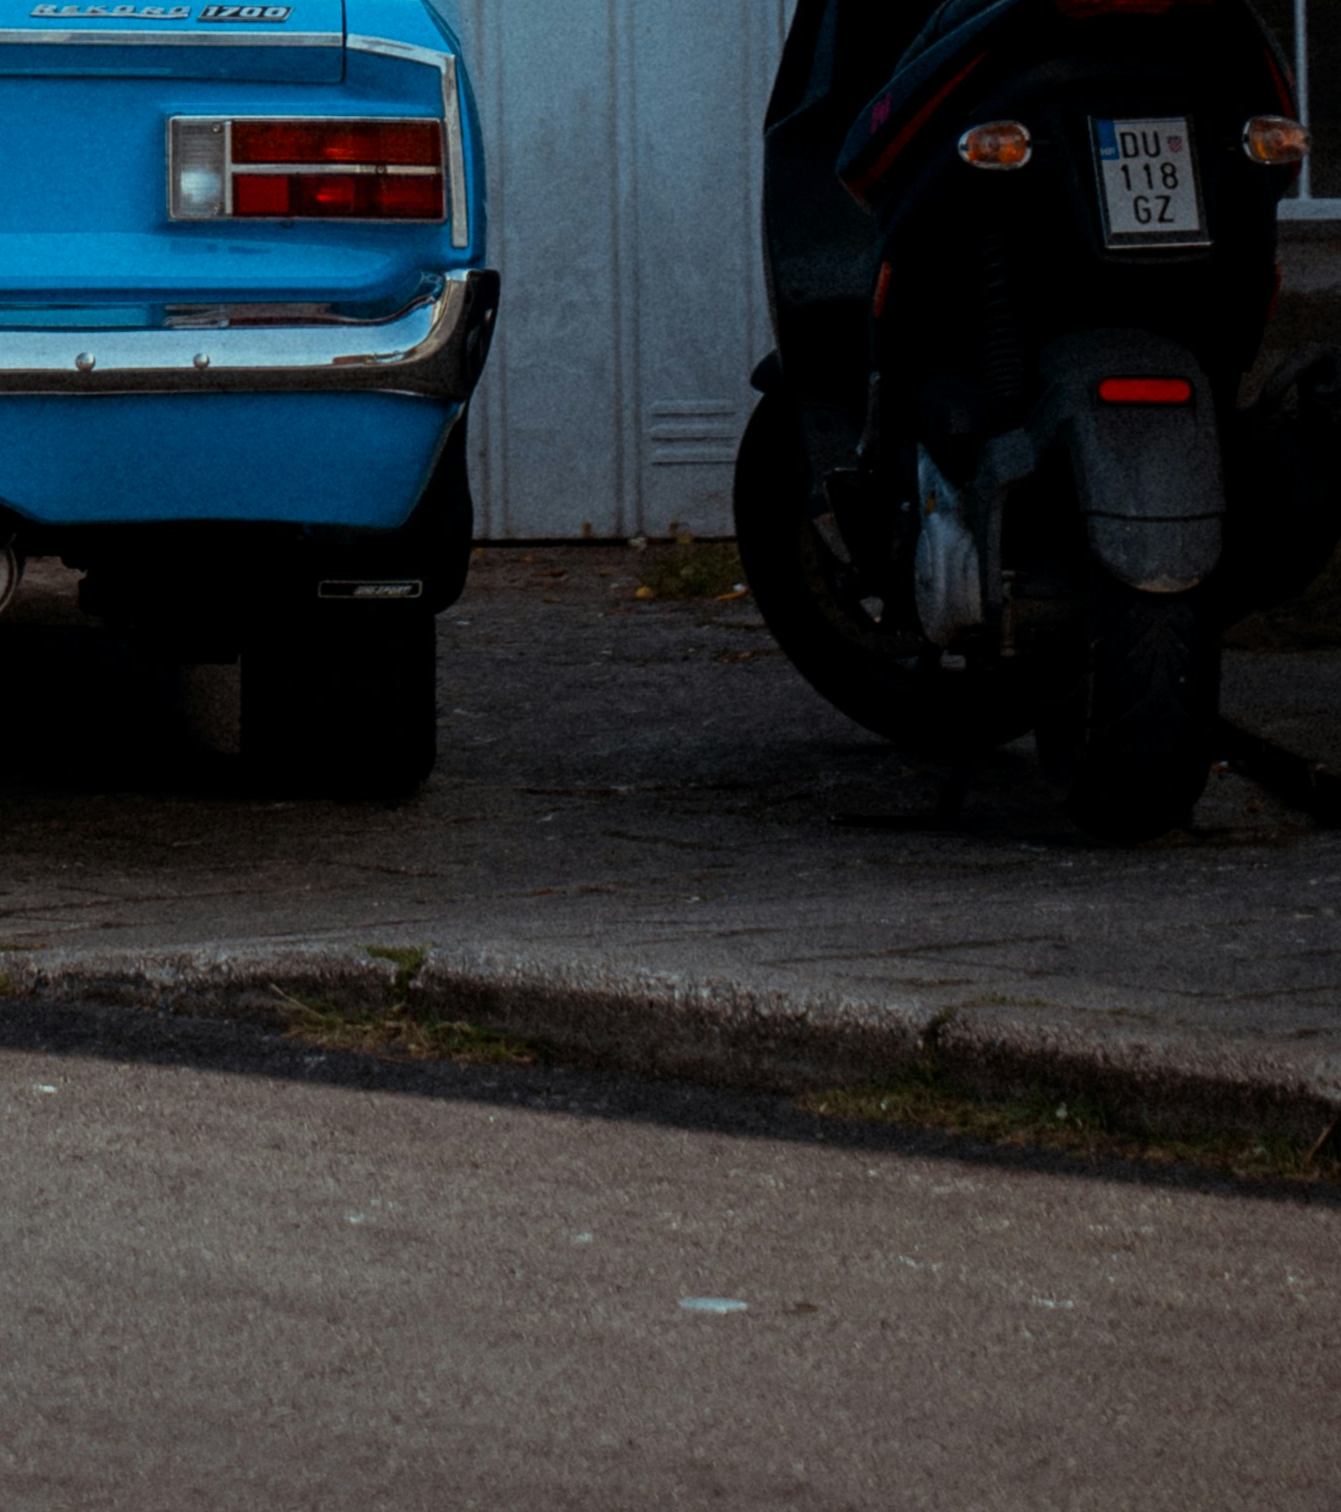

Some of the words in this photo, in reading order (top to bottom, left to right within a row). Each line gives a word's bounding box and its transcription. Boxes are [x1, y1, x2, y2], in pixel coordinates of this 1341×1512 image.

[203, 5, 290, 19] 1700
[1120, 131, 1161, 158] DU
[1121, 162, 1179, 191] 118
[1133, 195, 1174, 224] GZ
